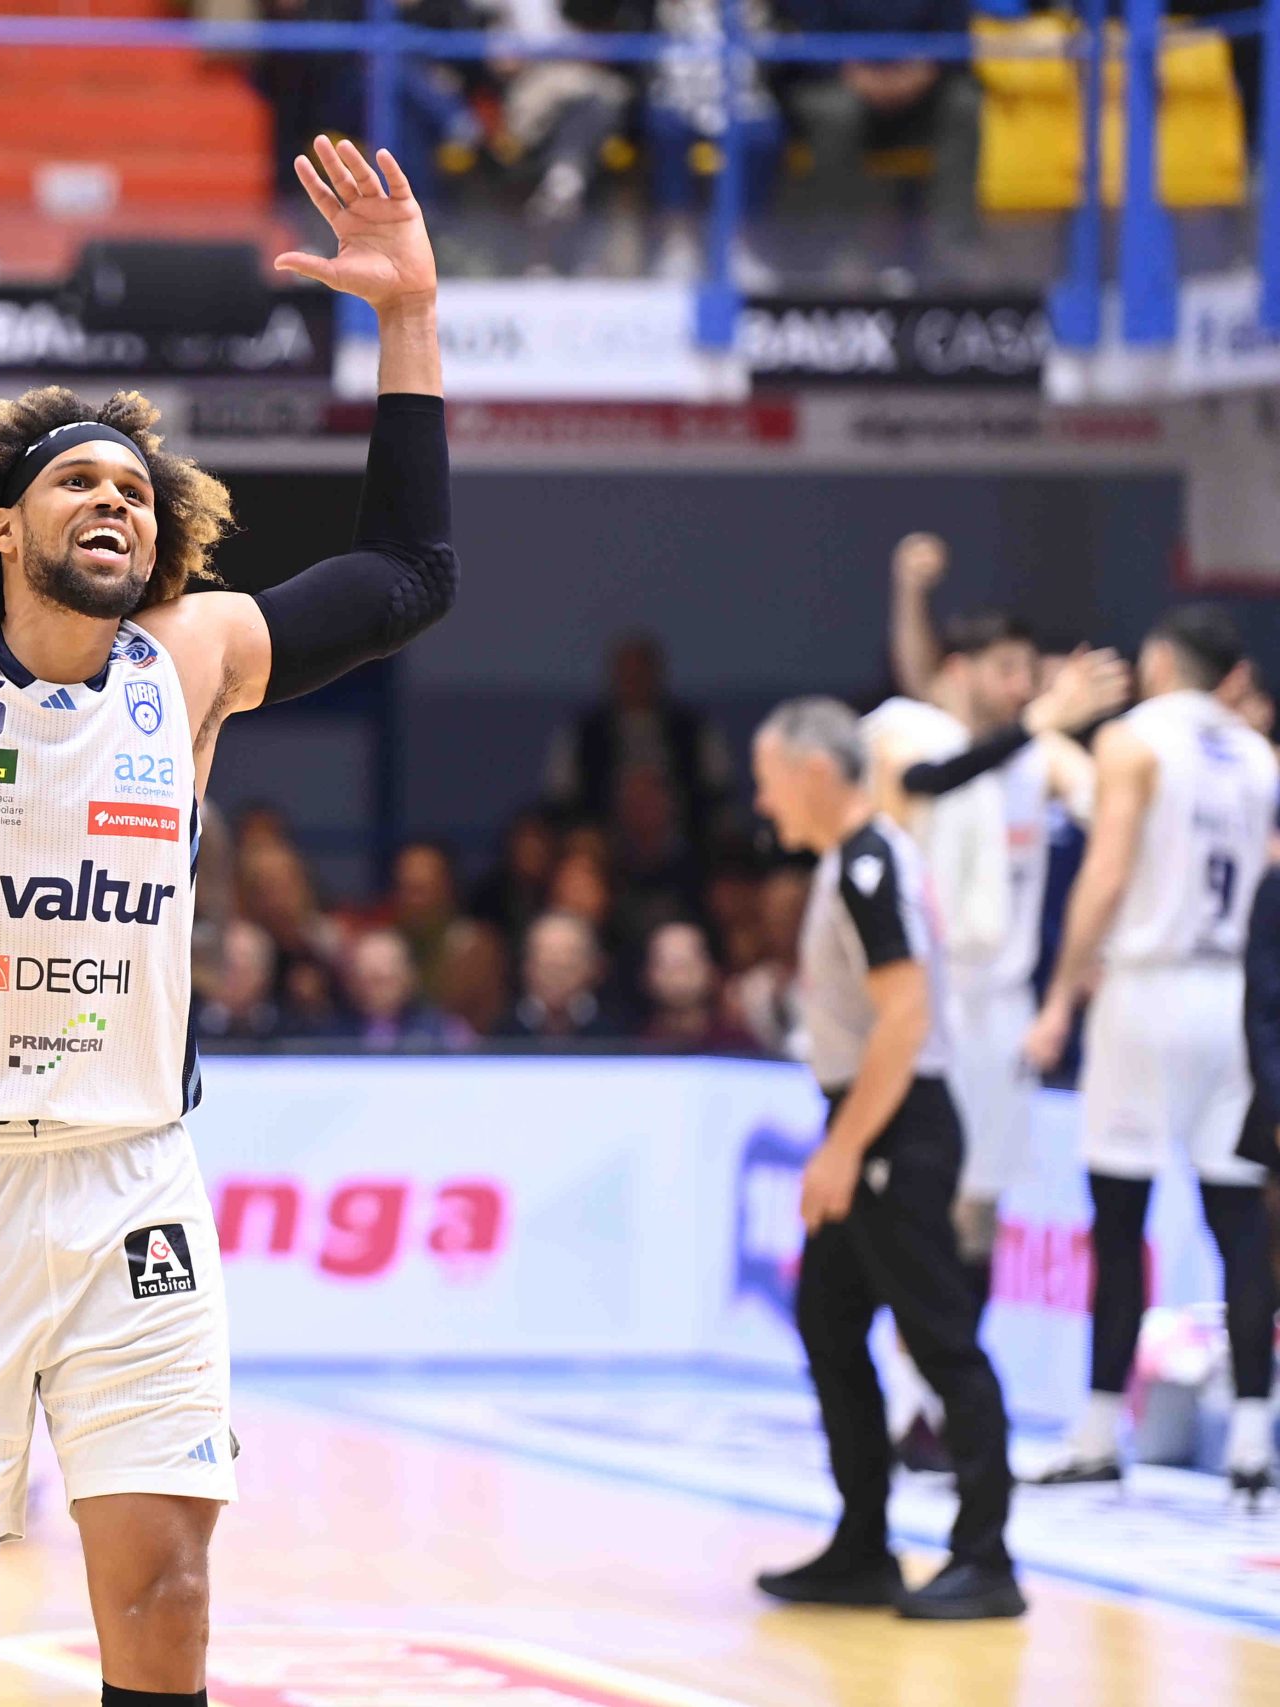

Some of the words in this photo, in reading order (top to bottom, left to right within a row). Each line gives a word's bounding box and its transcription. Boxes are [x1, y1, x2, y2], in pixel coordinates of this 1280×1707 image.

[732, 308, 898, 374] BAUX
[114, 753, 174, 786] a2a
[114, 784, 133, 794] LIFE
[135, 786, 175, 798] COMPANY
[107, 815, 159, 828] ANTENNA
[160, 819, 177, 830] SUD
[0, 859, 176, 925] valtur
[1206, 850, 1238, 920] 9
[16, 957, 131, 994] DEGHI
[9, 1034, 103, 1053] PRIMICERI
[138, 1277, 191, 1295] habitat
